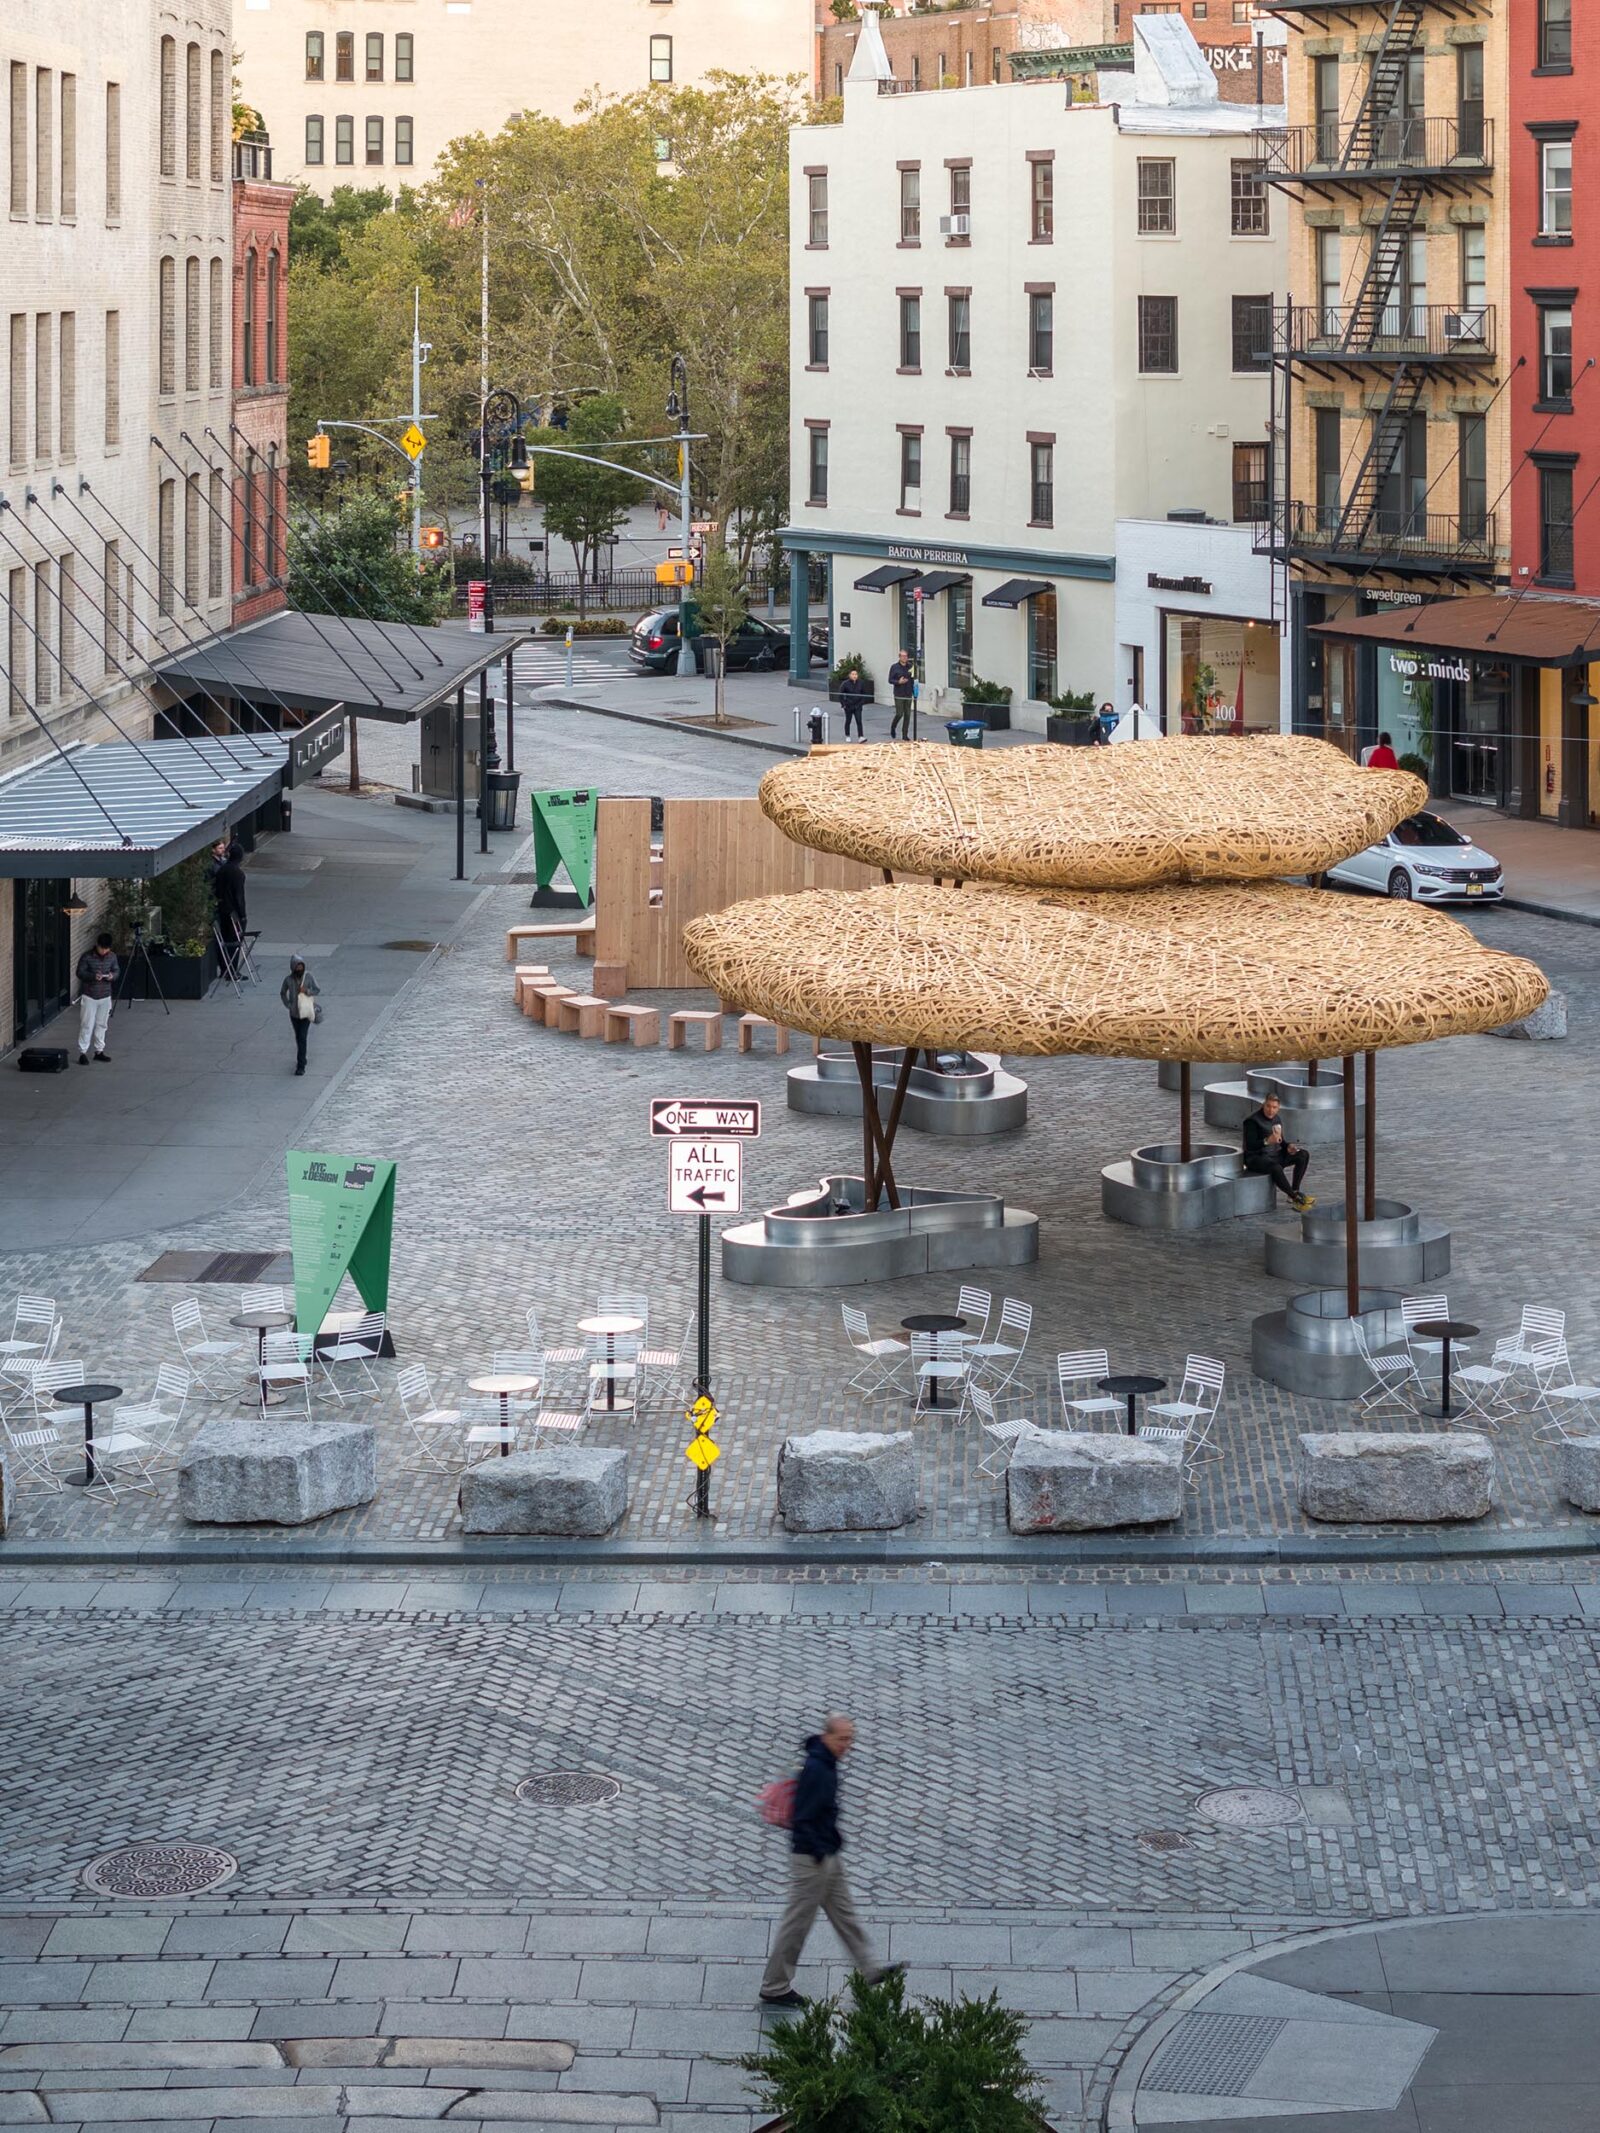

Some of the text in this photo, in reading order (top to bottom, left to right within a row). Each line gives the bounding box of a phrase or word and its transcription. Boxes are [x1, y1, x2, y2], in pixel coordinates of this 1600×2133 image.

[888, 546, 968, 564] BARTON PERREIRA
[1366, 589, 1422, 605] sweetgreen
[1390, 655, 1418, 675] two
[1428, 658, 1471, 682] minds
[1215, 704, 1236, 721] 100
[666, 1111, 749, 1126] ONE WAY
[687, 1147, 724, 1164] ALL
[309, 1162, 327, 1172] NYC
[675, 1168, 736, 1182] TRAFFIC
